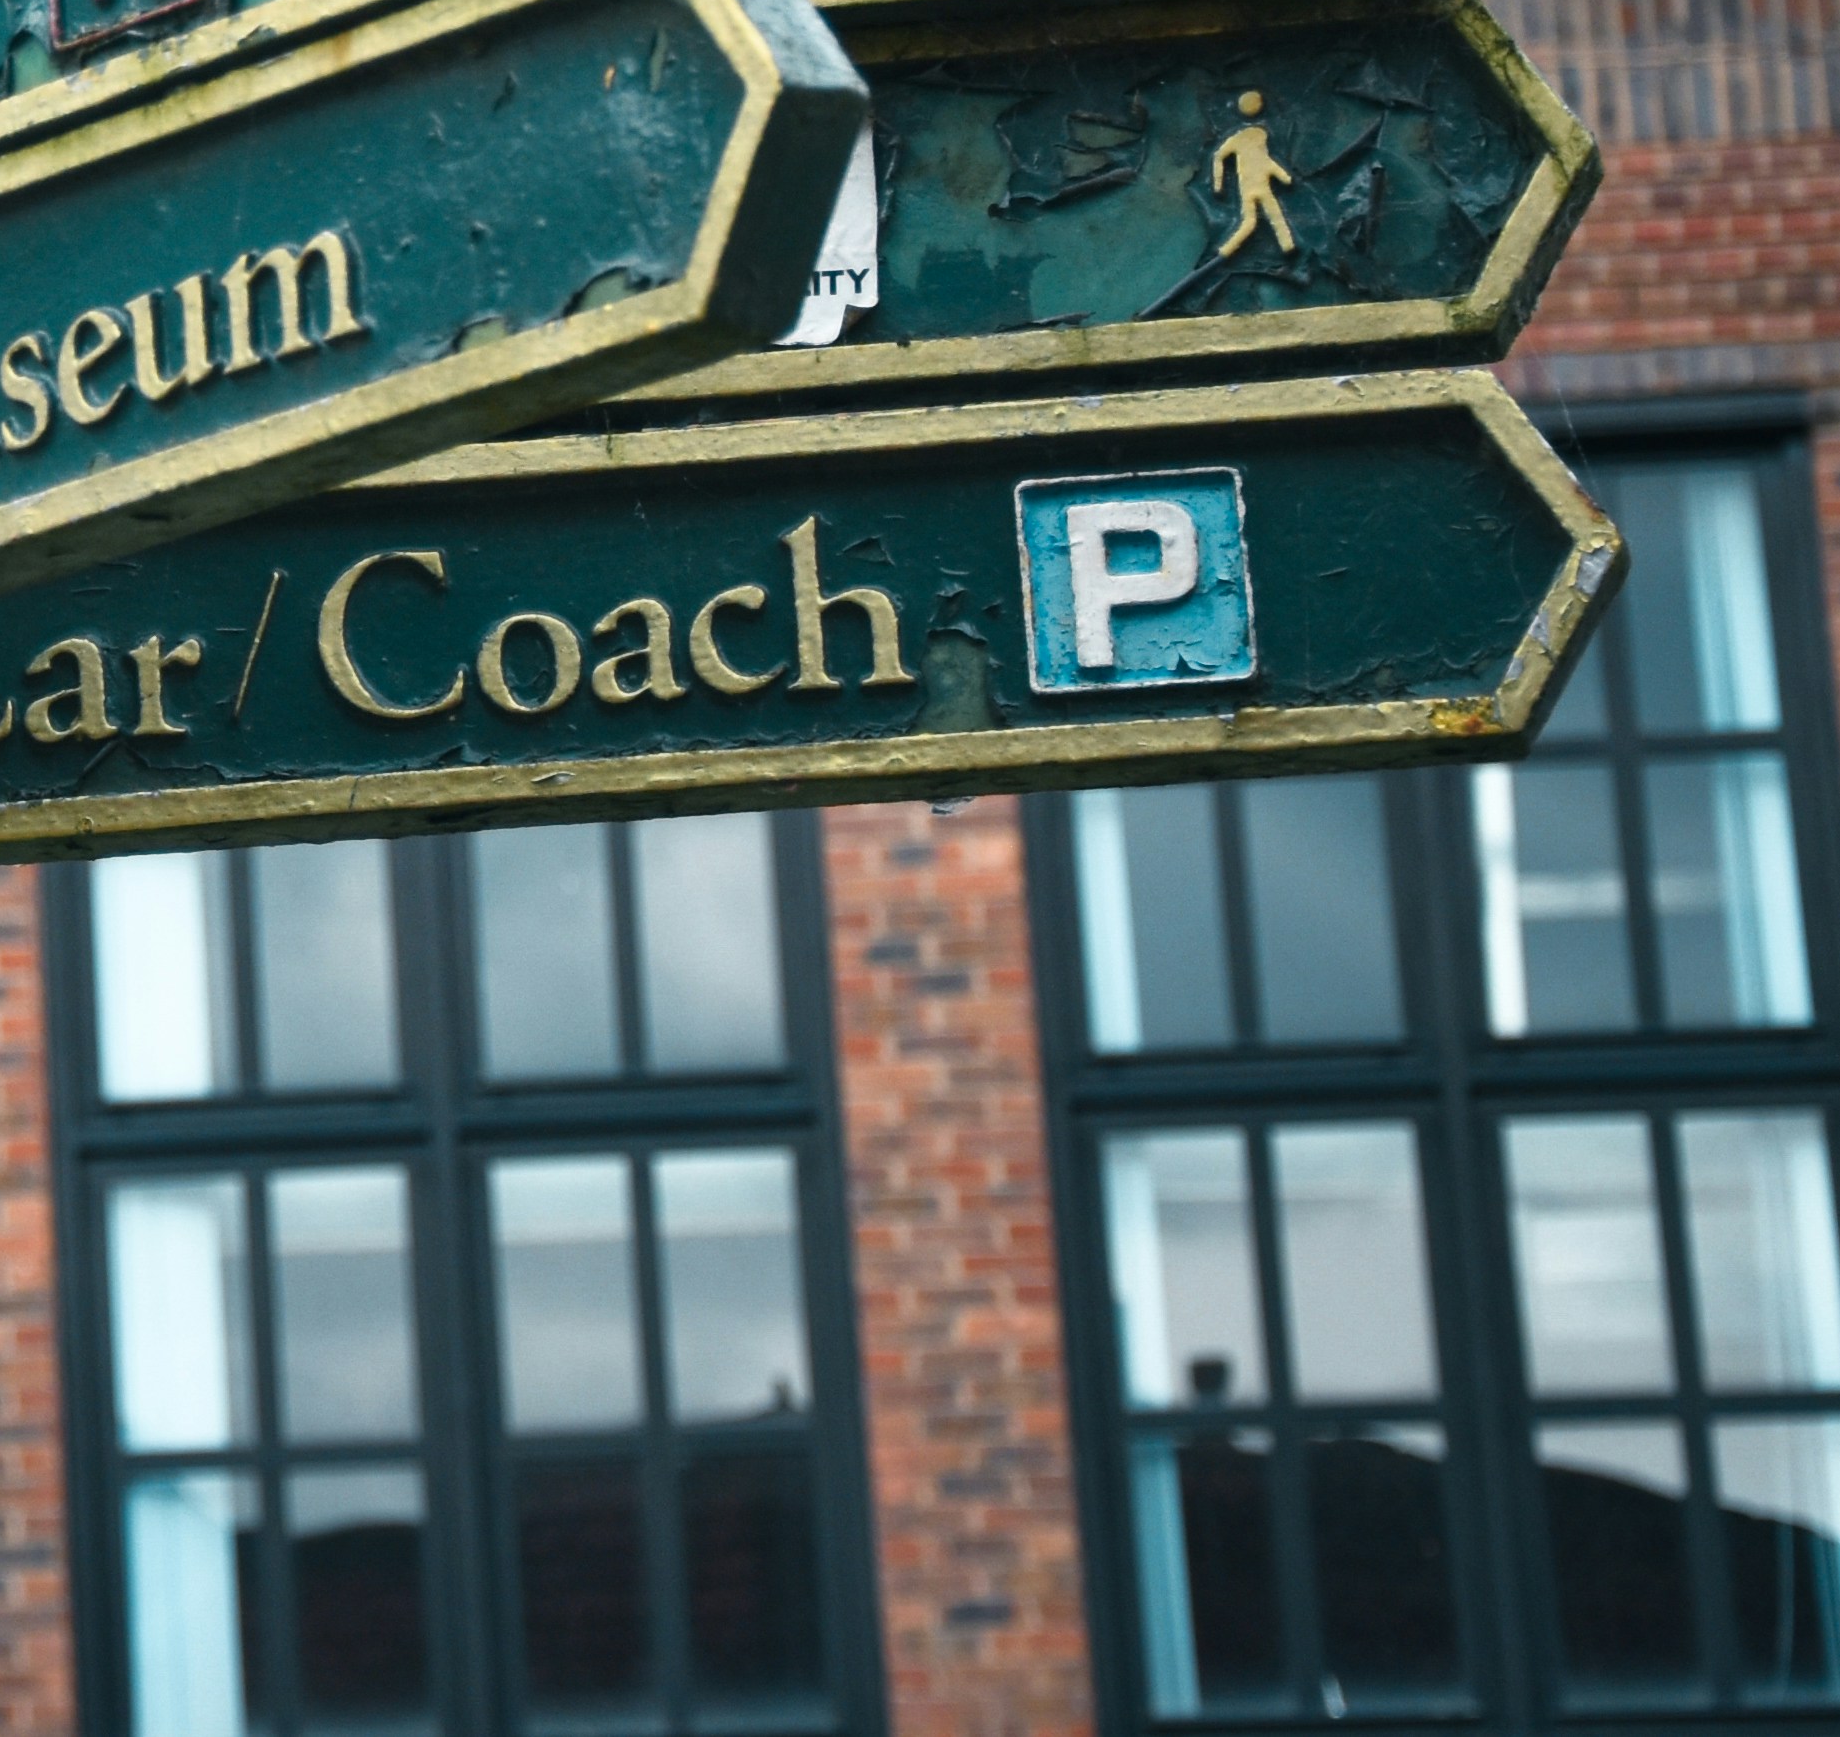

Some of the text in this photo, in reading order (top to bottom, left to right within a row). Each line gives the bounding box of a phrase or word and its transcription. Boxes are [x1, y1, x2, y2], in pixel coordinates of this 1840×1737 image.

[805, 267, 869, 296] ITY
[320, 514, 915, 718] Coach
[1065, 500, 1199, 669] P
